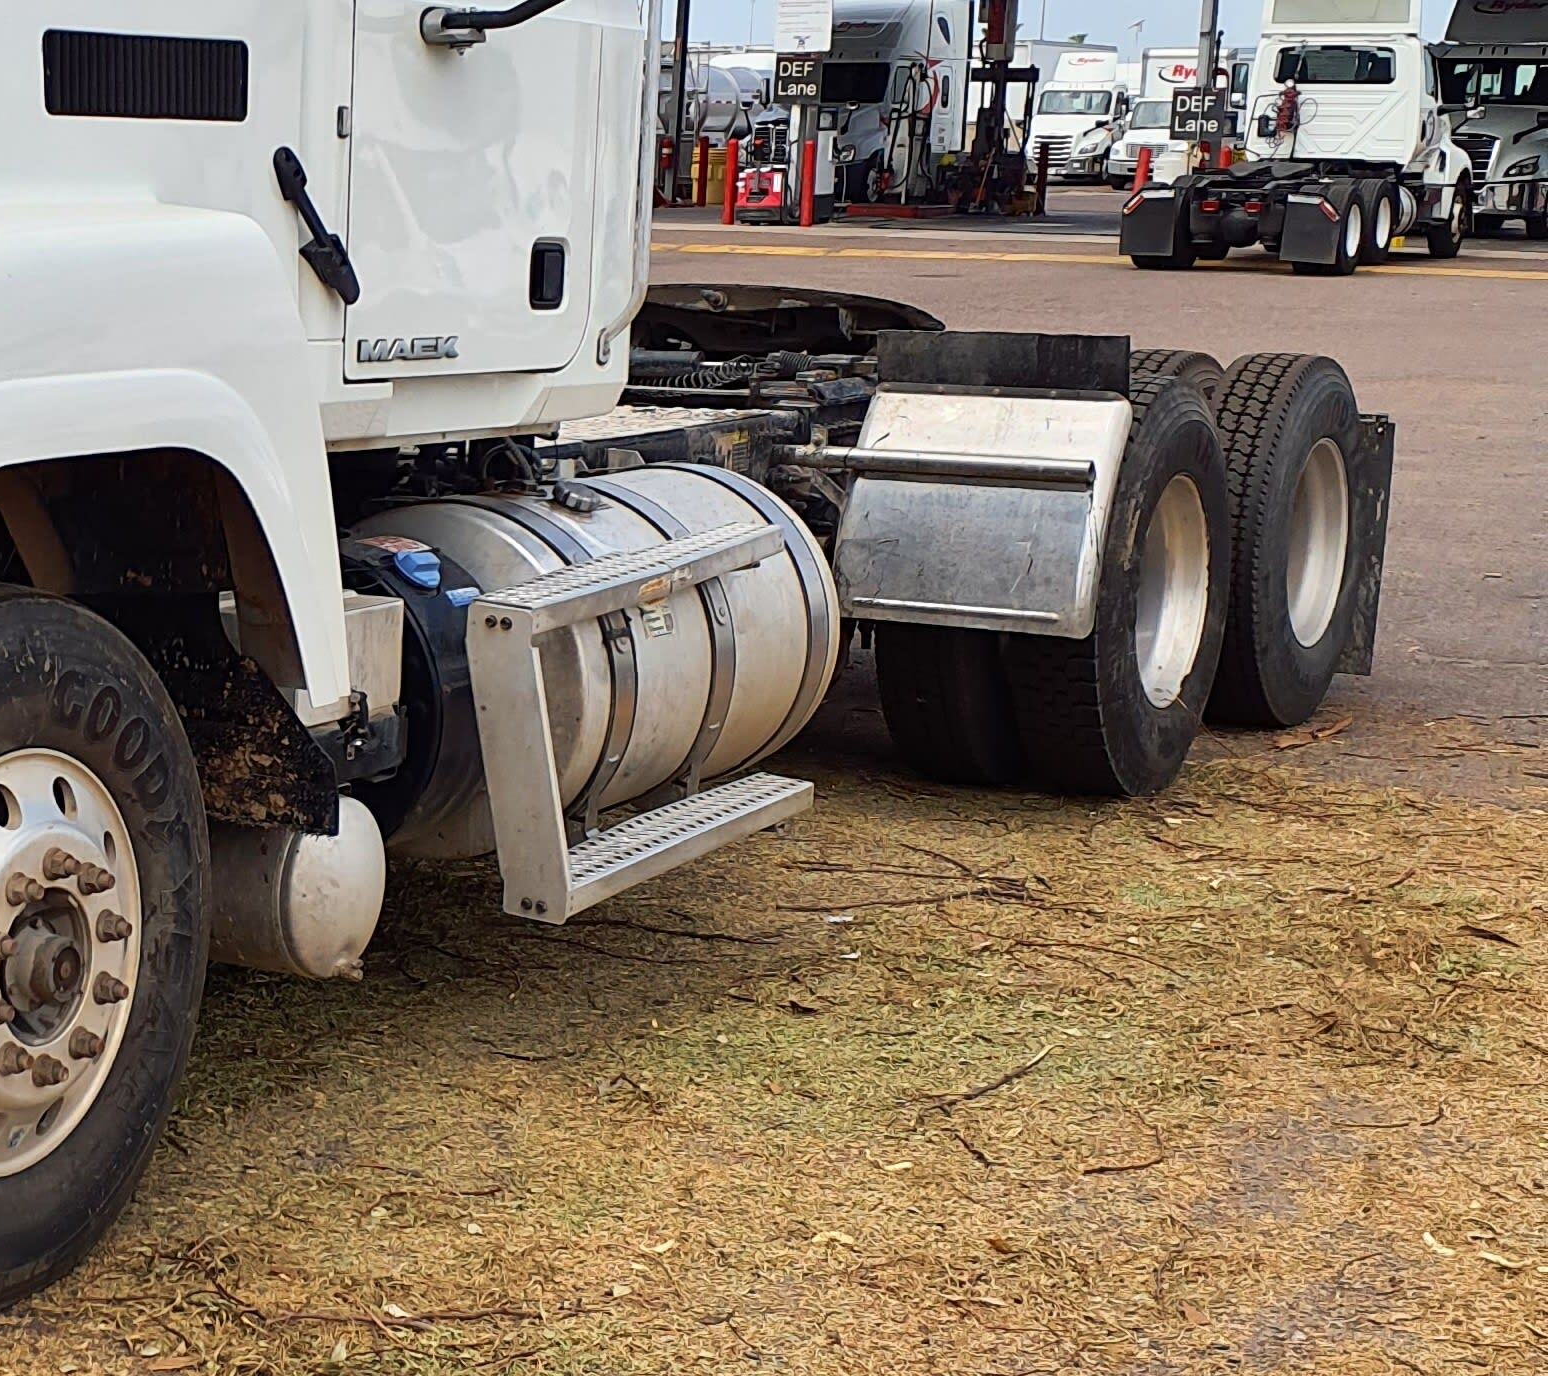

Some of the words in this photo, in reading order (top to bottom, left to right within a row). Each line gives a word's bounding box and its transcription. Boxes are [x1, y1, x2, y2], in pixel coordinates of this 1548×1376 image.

[779, 61, 815, 77] DEF
[777, 79, 817, 96] Lane
[1176, 95, 1216, 112] DEF
[1174, 115, 1219, 132] Lane
